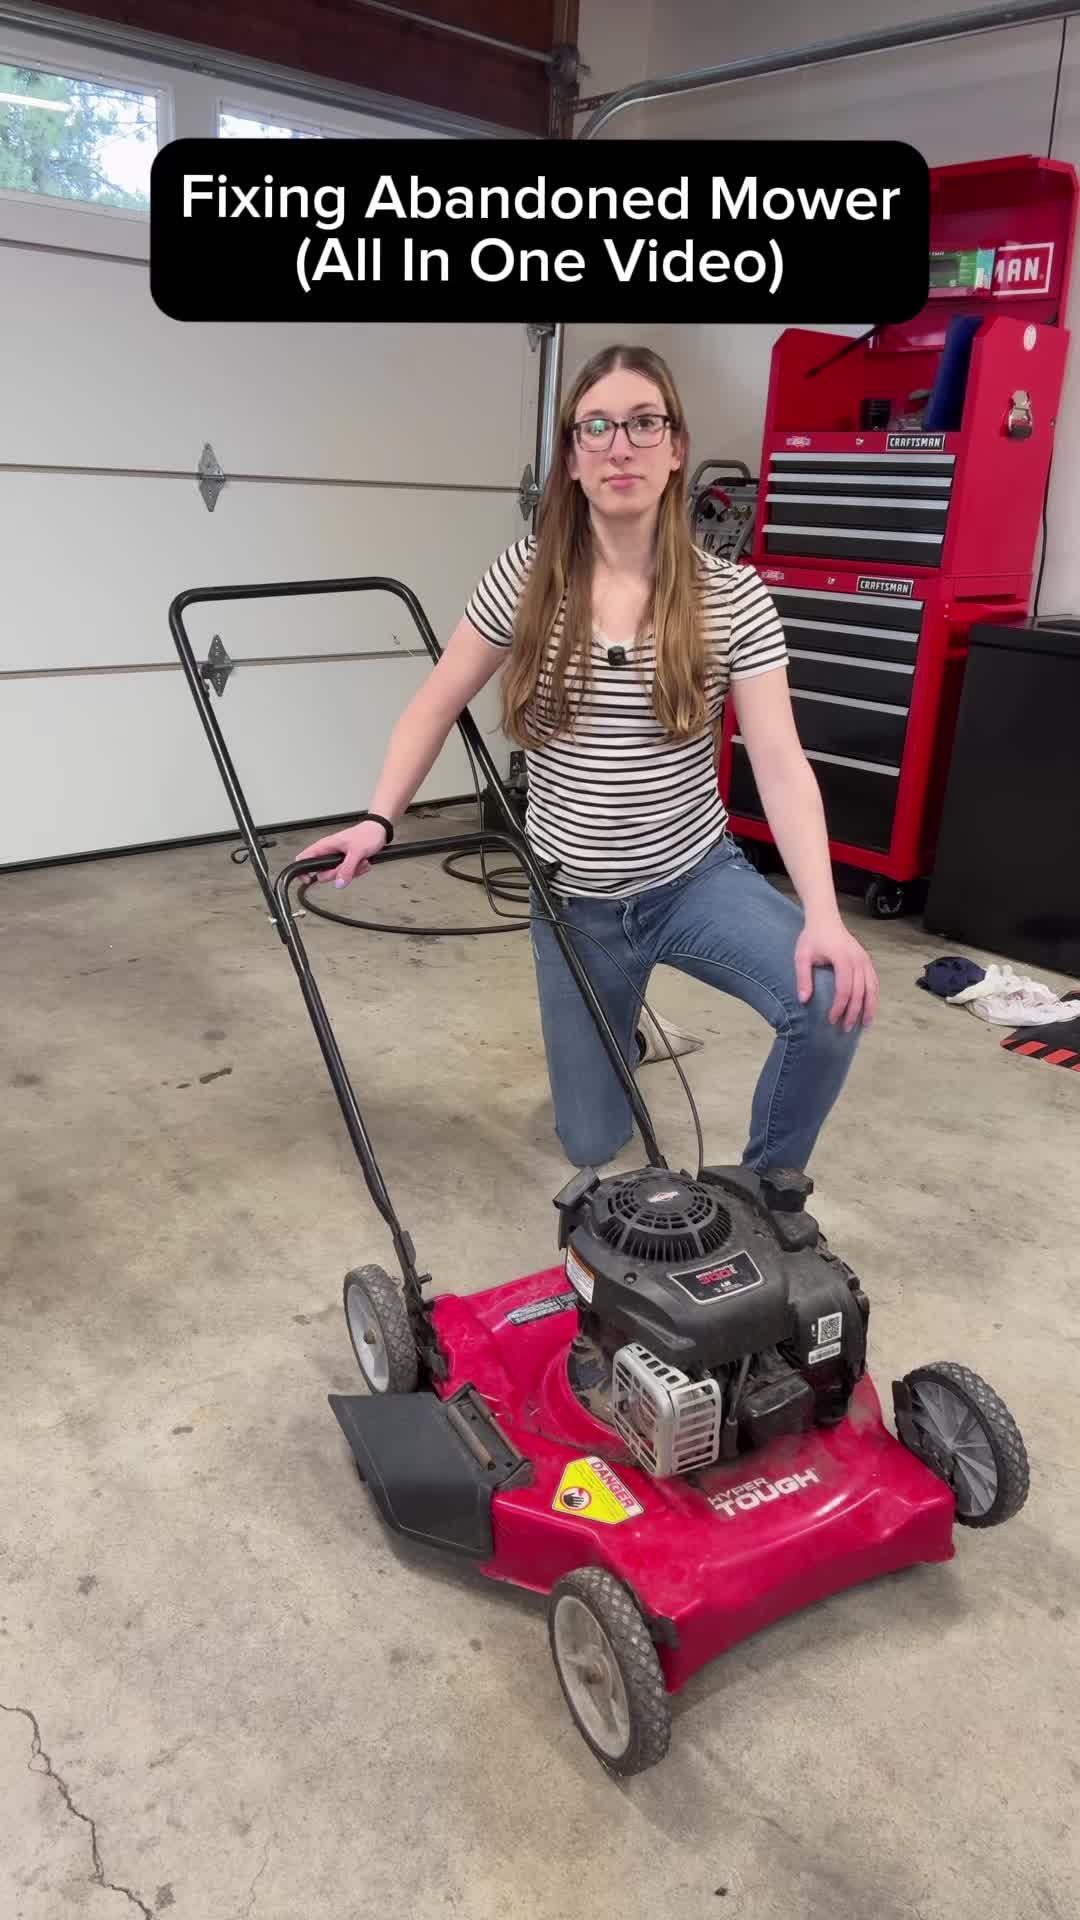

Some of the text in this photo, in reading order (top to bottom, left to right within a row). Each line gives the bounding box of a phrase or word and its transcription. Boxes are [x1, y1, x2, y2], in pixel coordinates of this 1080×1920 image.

[889, 437, 941, 448] CRAFTSMAN
[860, 580, 909, 593] CRAFTSMAN
[591, 1461, 635, 1509] DANGER
[707, 1477, 769, 1506] HYPER
[714, 1467, 820, 1517] TOUGH
